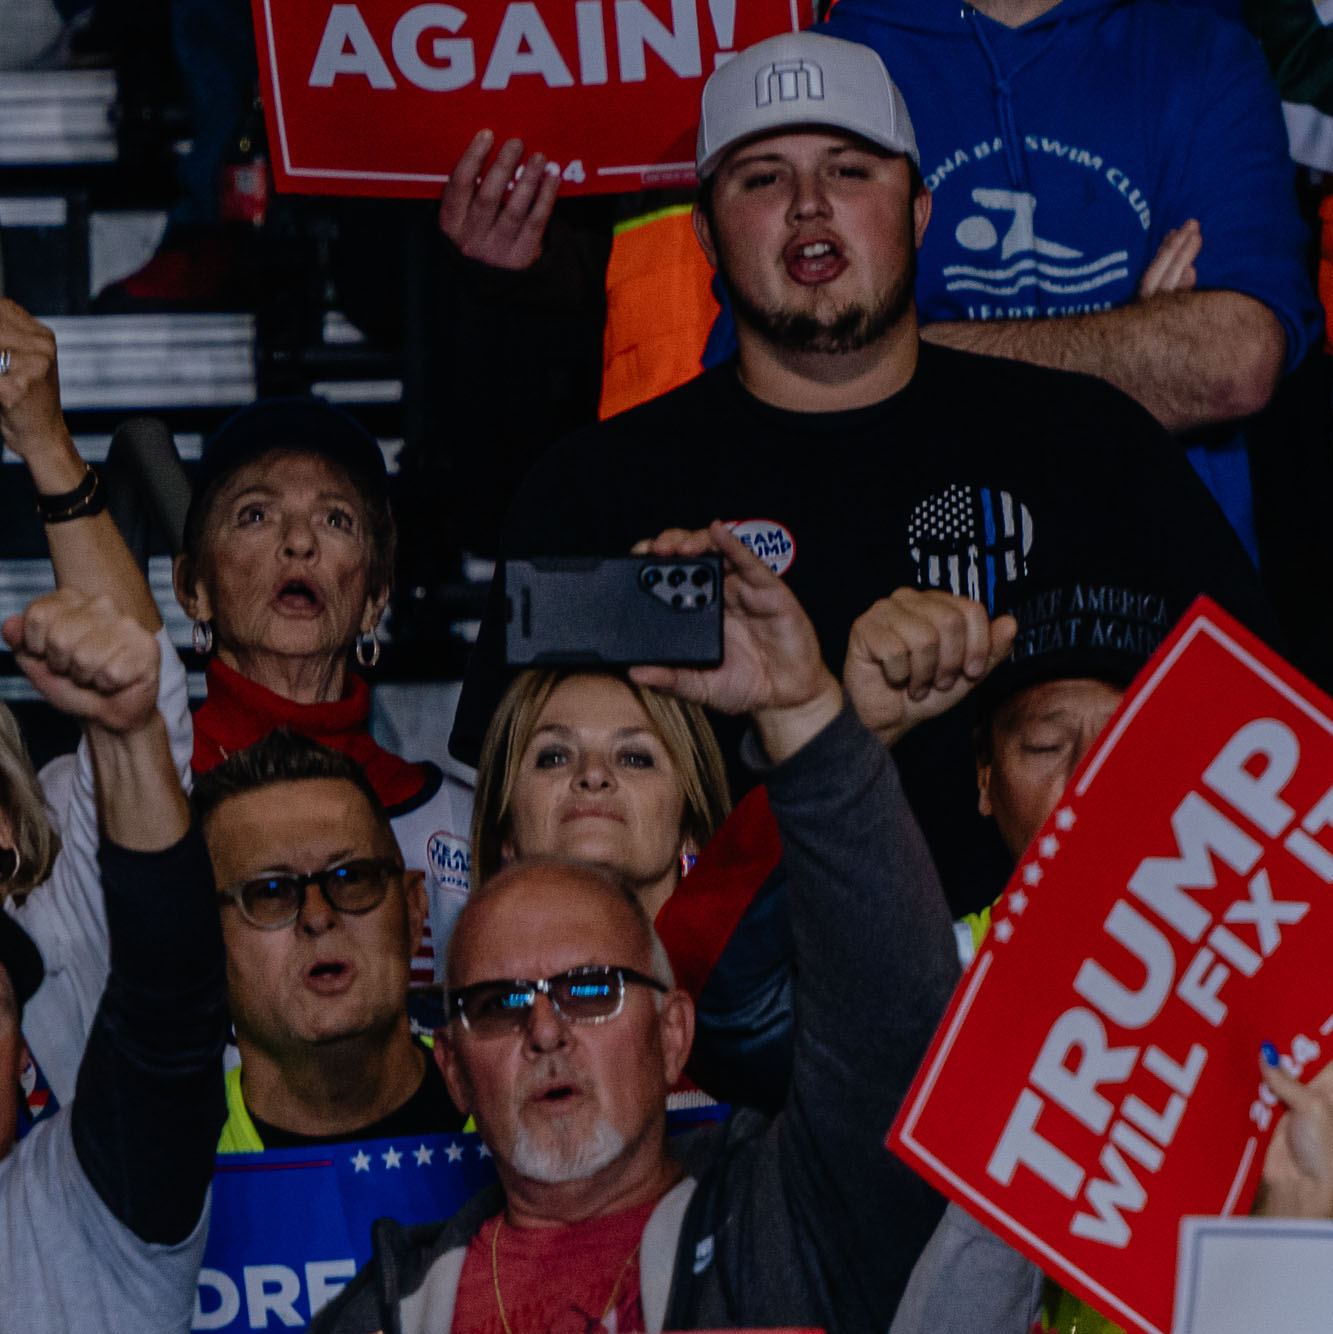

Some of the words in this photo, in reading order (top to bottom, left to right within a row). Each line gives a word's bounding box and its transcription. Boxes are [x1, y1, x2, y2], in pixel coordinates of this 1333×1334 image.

[308, 0, 738, 91] AGAIN!
[1022, 135, 1103, 169] SWIM
[1104, 166, 1151, 231] CLUB
[741, 530, 784, 547] EAM
[986, 717, 1300, 1199] TRUMP
[1069, 1043, 1208, 1248] WILL
[1177, 868, 1310, 1027] FIX
[191, 1257, 357, 1331] DRE
